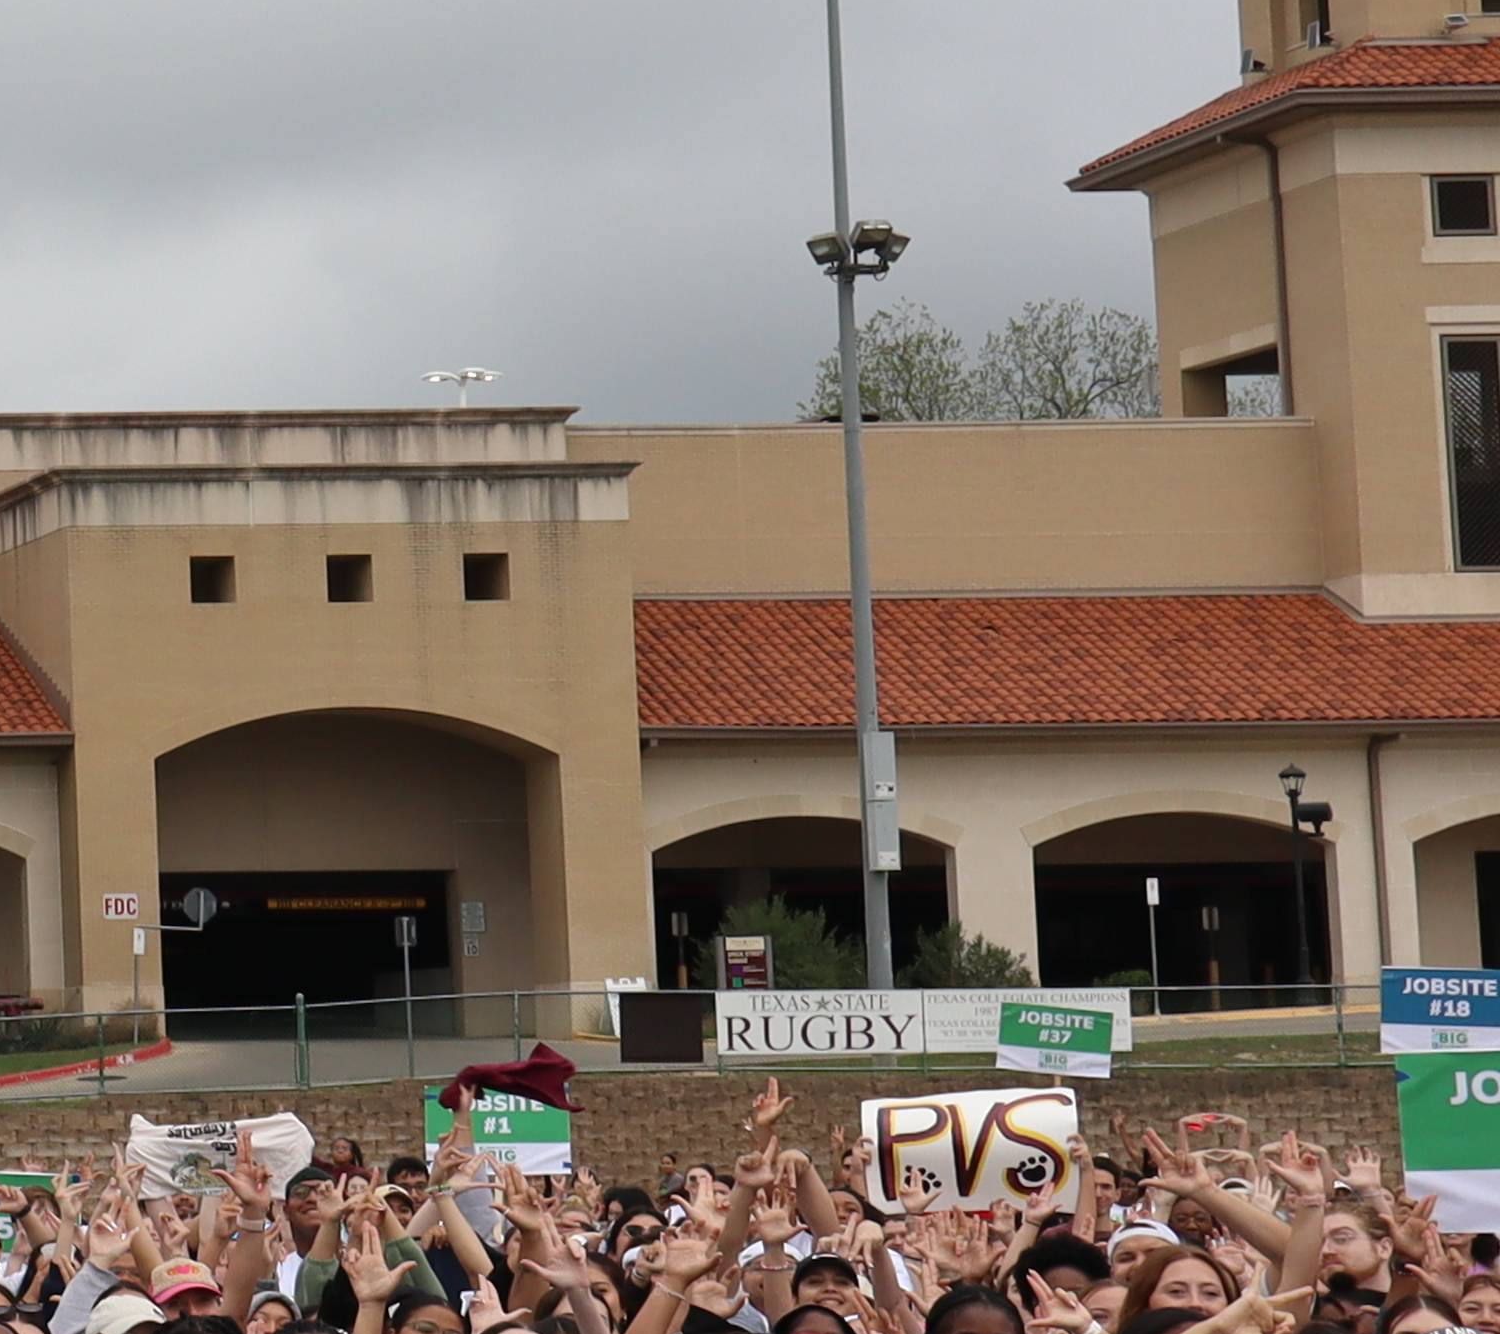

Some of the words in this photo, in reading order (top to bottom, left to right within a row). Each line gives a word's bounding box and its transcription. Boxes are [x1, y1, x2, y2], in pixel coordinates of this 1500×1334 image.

[104, 897, 137, 916] FDC
[1402, 977, 1498, 997] JOBSITE
[750, 994, 810, 1012] TEXAS
[833, 994, 889, 1011] STATE
[927, 993, 967, 1004] TEXAS
[969, 993, 1046, 1004] COLLEGIATE
[1050, 992, 1127, 1003] CHAMPIONS
[1429, 999, 1471, 1017] #18
[1018, 1011, 1095, 1030] JOBSITE
[724, 1014, 917, 1052] RUGBY
[1038, 1029, 1072, 1044] #37
[1439, 1032, 1469, 1044] BIG
[1044, 1054, 1068, 1064] BIG
[450, 1094, 545, 1112] BSITE
[483, 1117, 512, 1134] #1
[876, 1093, 1074, 1201] PVS
